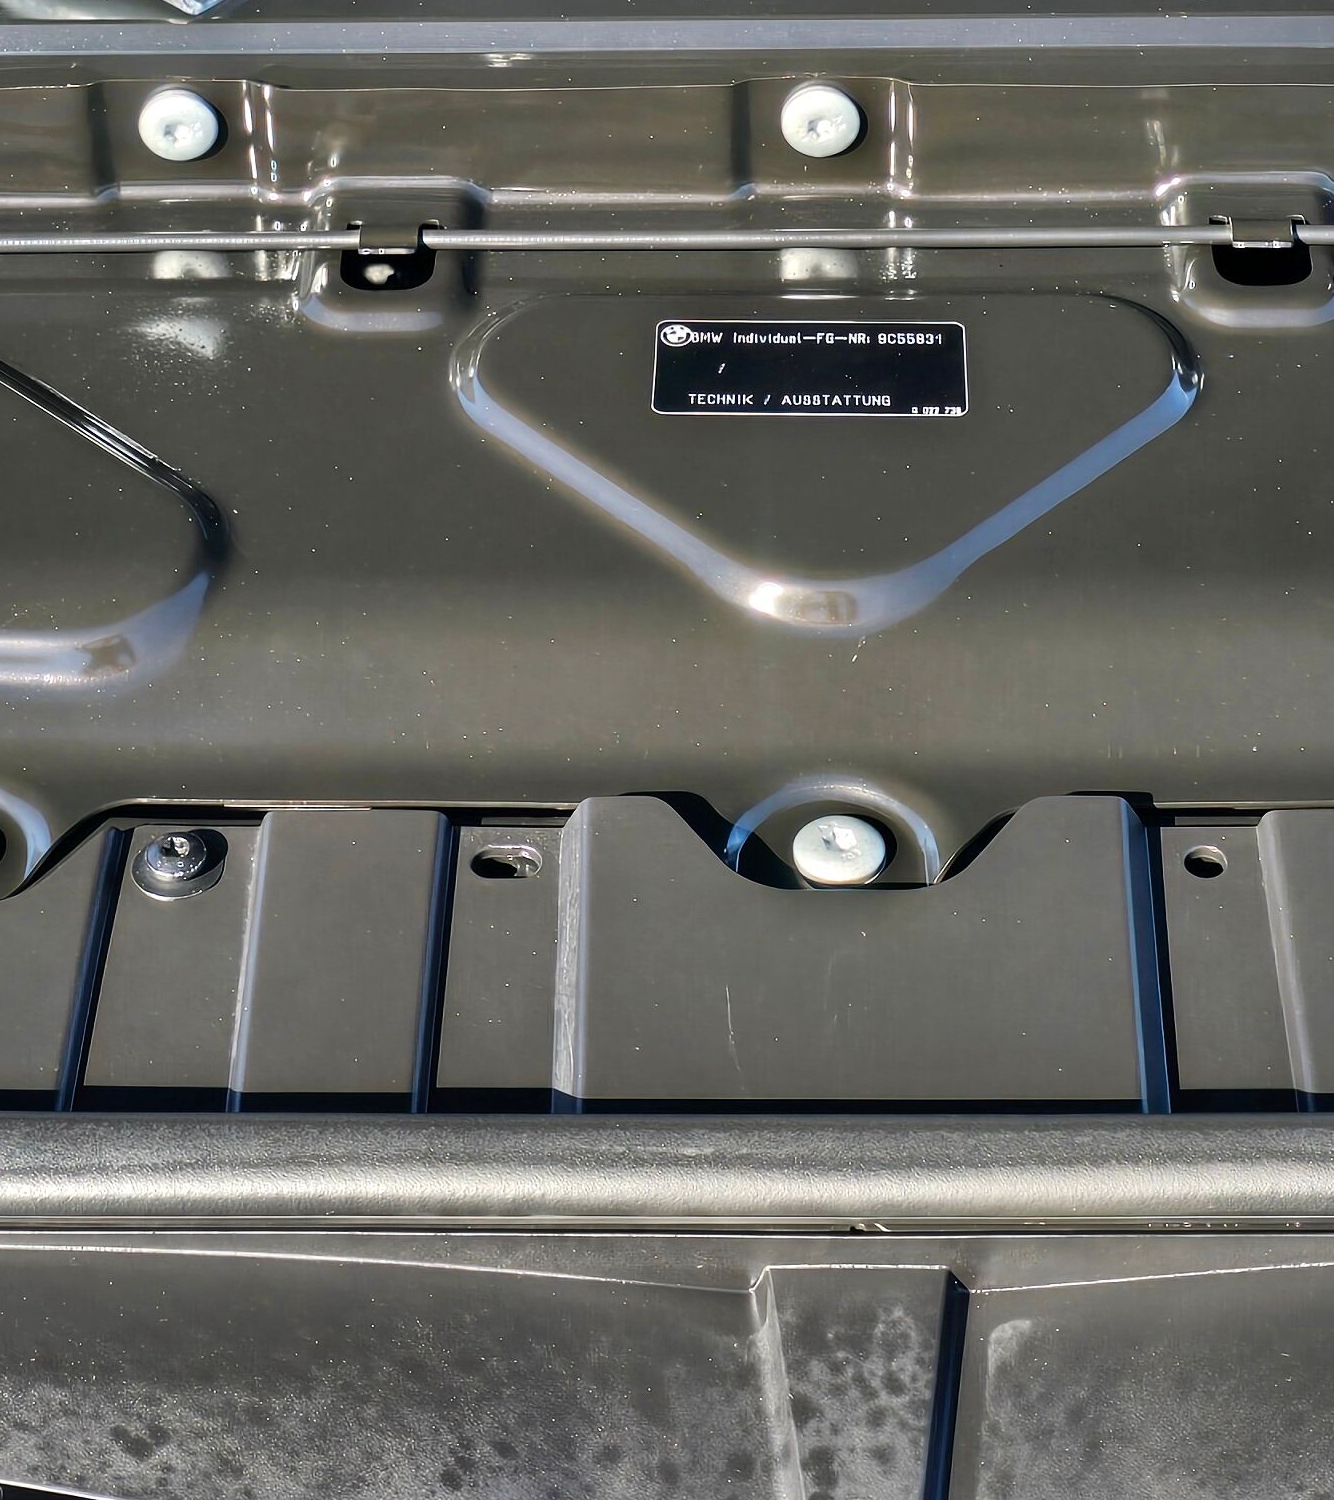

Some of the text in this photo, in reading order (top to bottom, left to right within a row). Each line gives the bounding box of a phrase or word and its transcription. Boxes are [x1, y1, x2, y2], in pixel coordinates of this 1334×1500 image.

[691, 332, 724, 344] BMW
[688, 393, 754, 405] TECHNIK
[781, 394, 891, 407] AUSSTATTUNG
